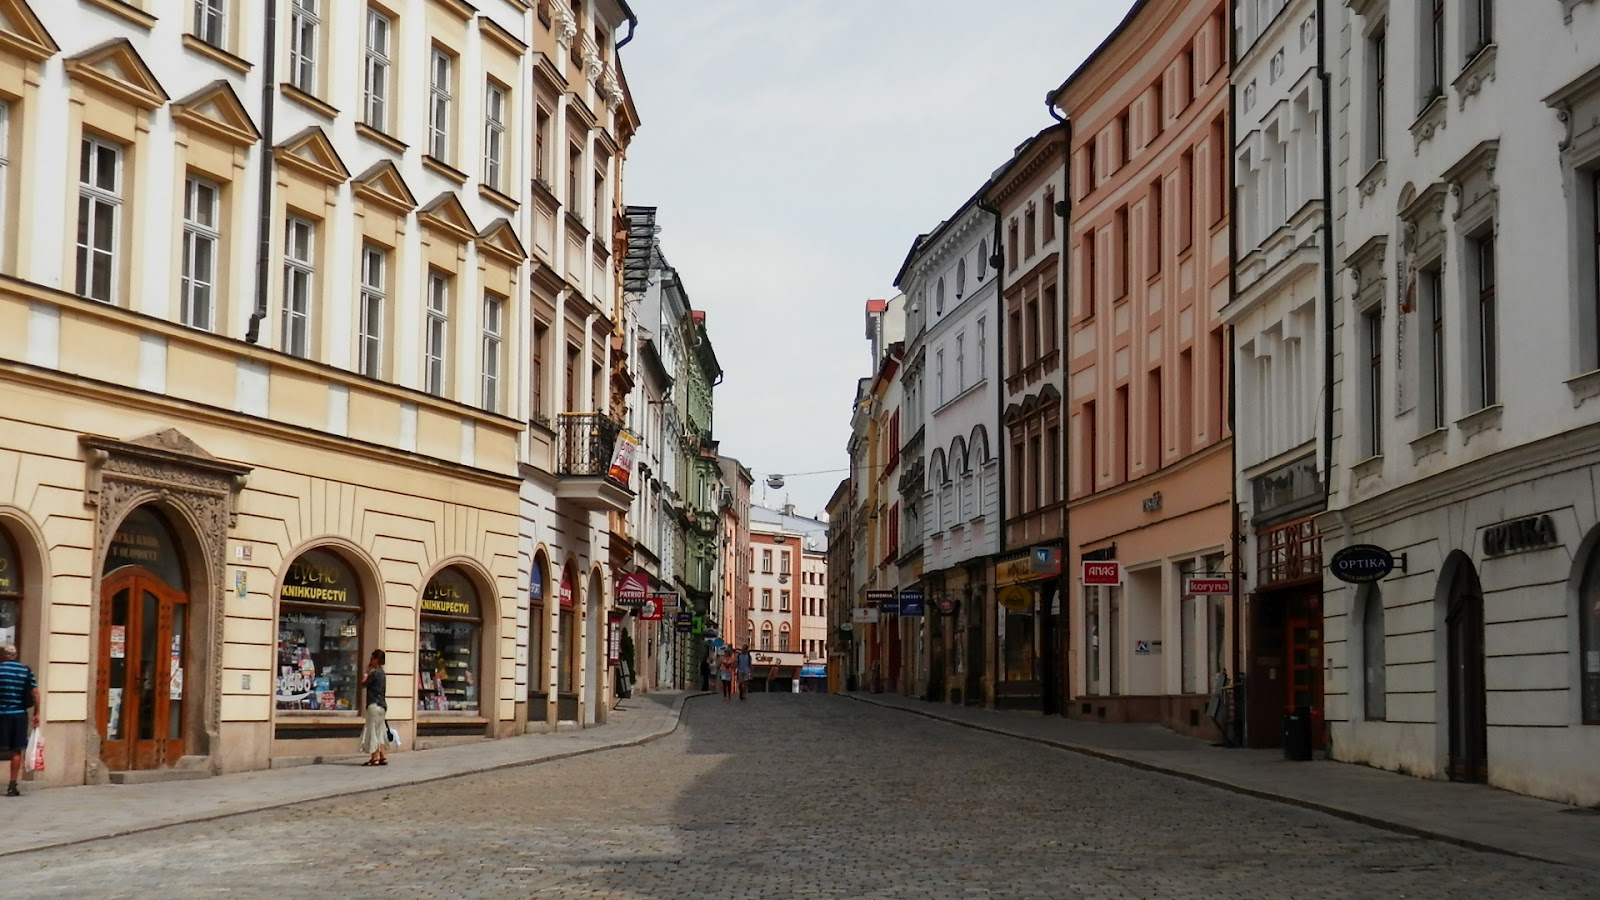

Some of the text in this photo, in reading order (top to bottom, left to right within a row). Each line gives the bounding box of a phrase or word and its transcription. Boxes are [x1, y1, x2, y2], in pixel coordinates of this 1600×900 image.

[1483, 515, 1557, 556] OPTIKA
[1339, 558, 1386, 570] OPTIKA
[1088, 566, 1114, 576] ANAG
[1190, 580, 1229, 592] koryna
[282, 584, 347, 602] KNIHKUPECTVÍ
